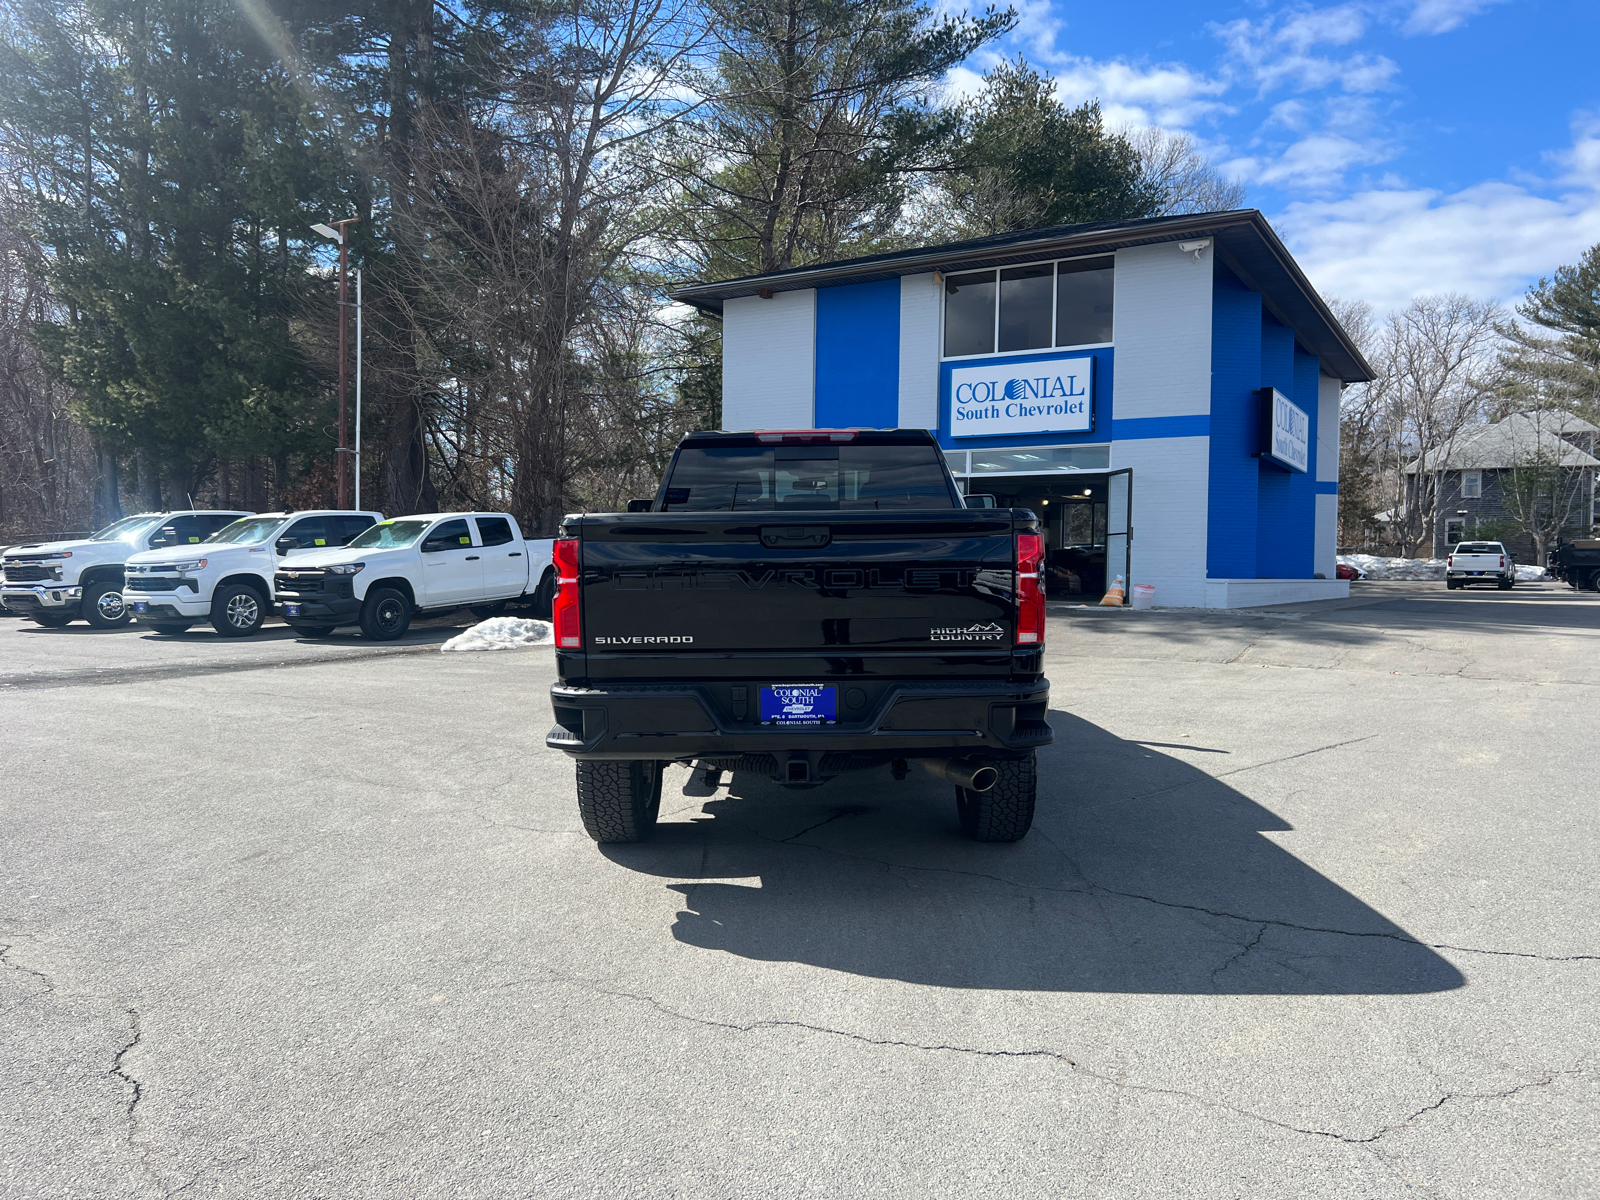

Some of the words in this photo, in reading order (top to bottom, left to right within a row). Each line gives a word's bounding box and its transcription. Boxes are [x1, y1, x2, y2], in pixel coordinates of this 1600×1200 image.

[956, 375, 1085, 404] COLONIAL
[956, 404, 1000, 421] South
[1005, 400, 1085, 418] Chevrolet
[613, 566, 982, 591] CHEVROLET
[594, 636, 694, 645] SILVERADO
[774, 689, 821, 697] COLONIAL
[781, 696, 814, 705] SOUTH
